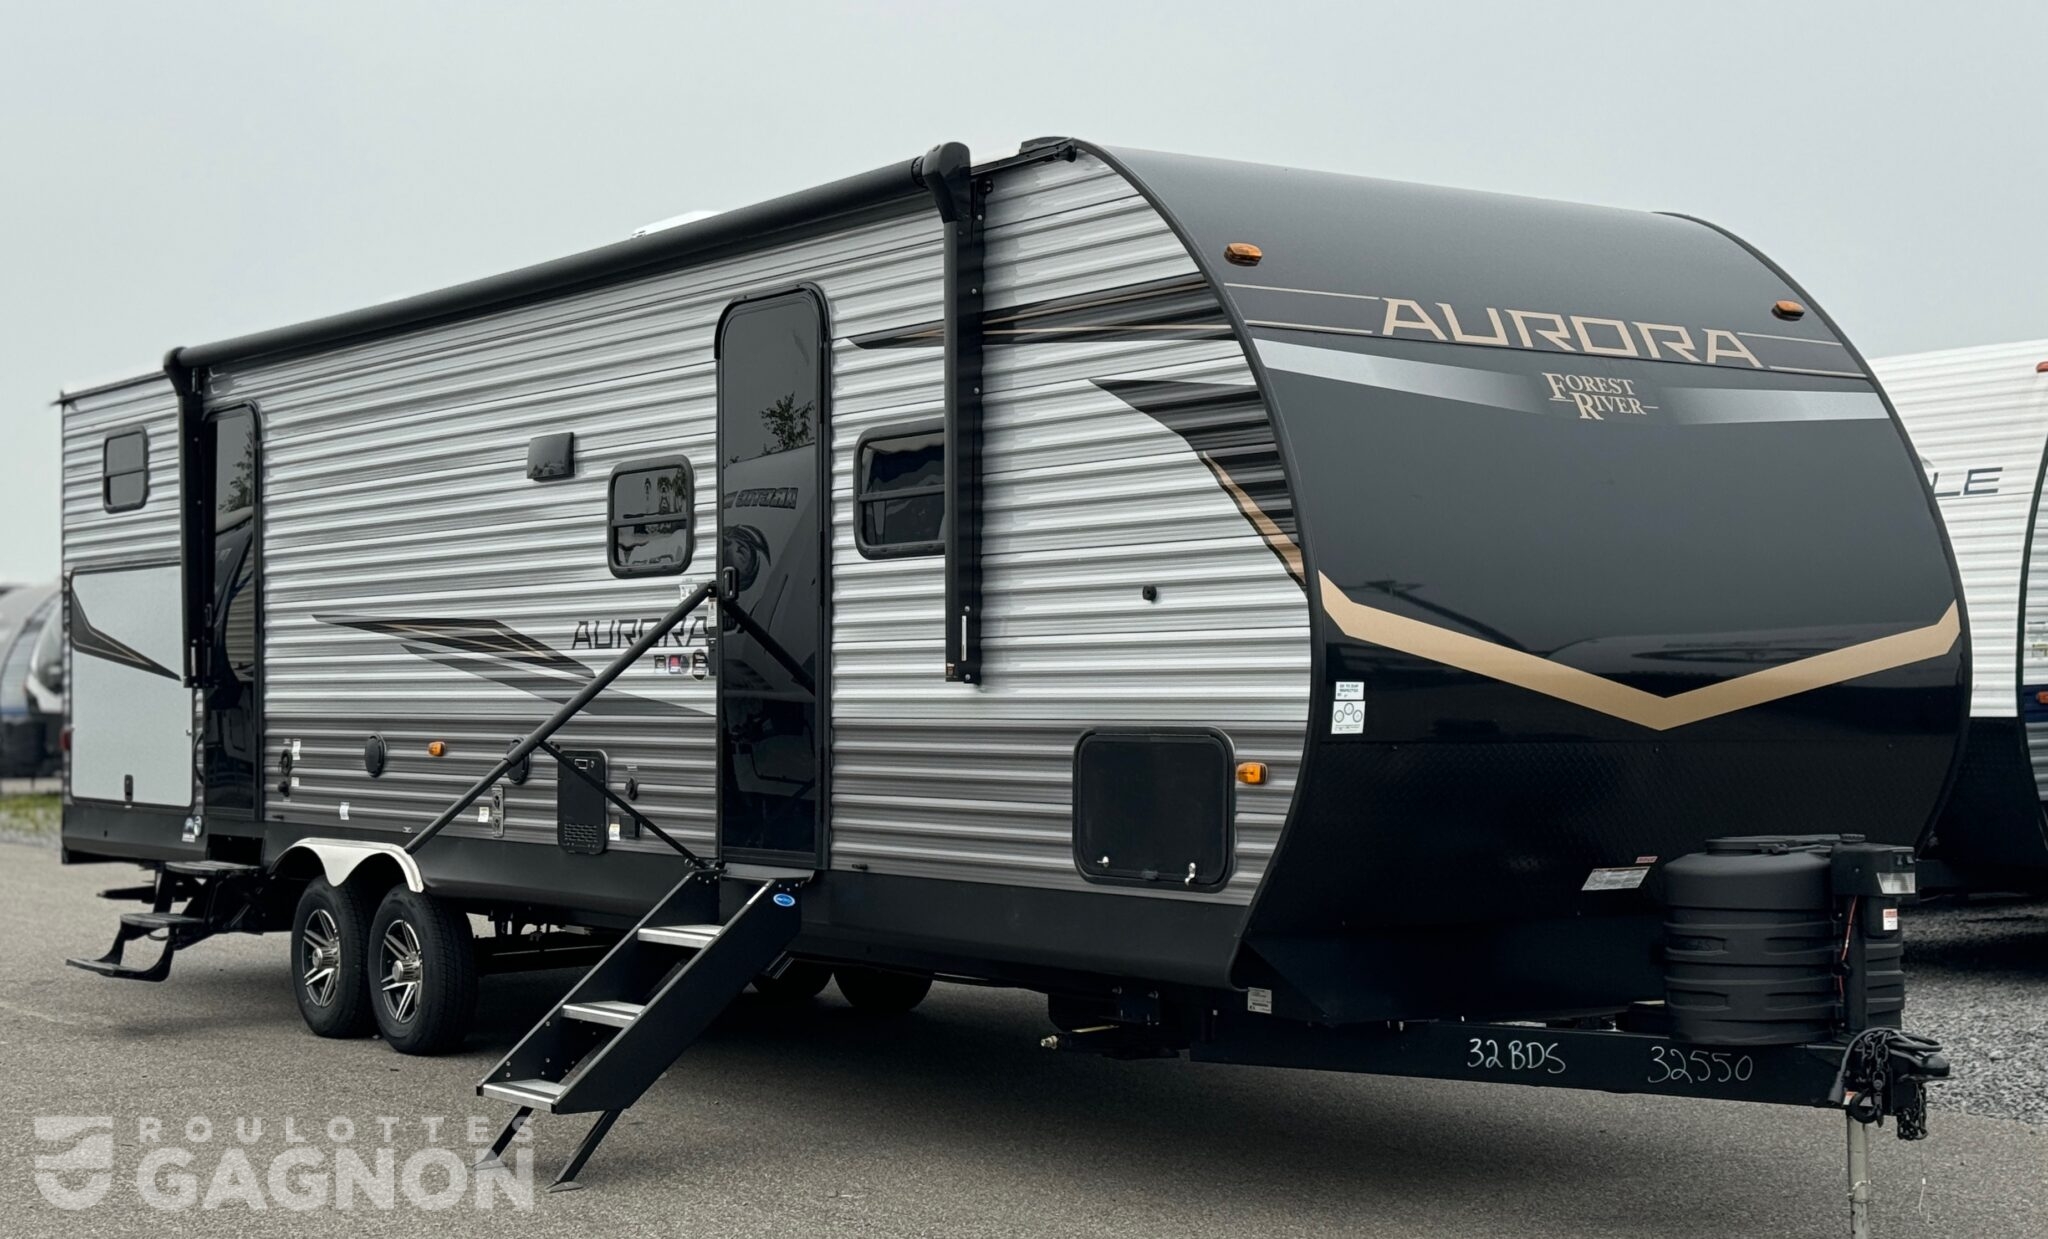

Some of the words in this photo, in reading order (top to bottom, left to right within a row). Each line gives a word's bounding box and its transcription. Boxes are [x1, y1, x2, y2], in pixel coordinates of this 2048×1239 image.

[1381, 298, 1763, 367] AURORA
[1543, 372, 1634, 400] FOREST
[1575, 392, 1646, 420] RIVER
[1647, 1046, 1753, 1084] 32550
